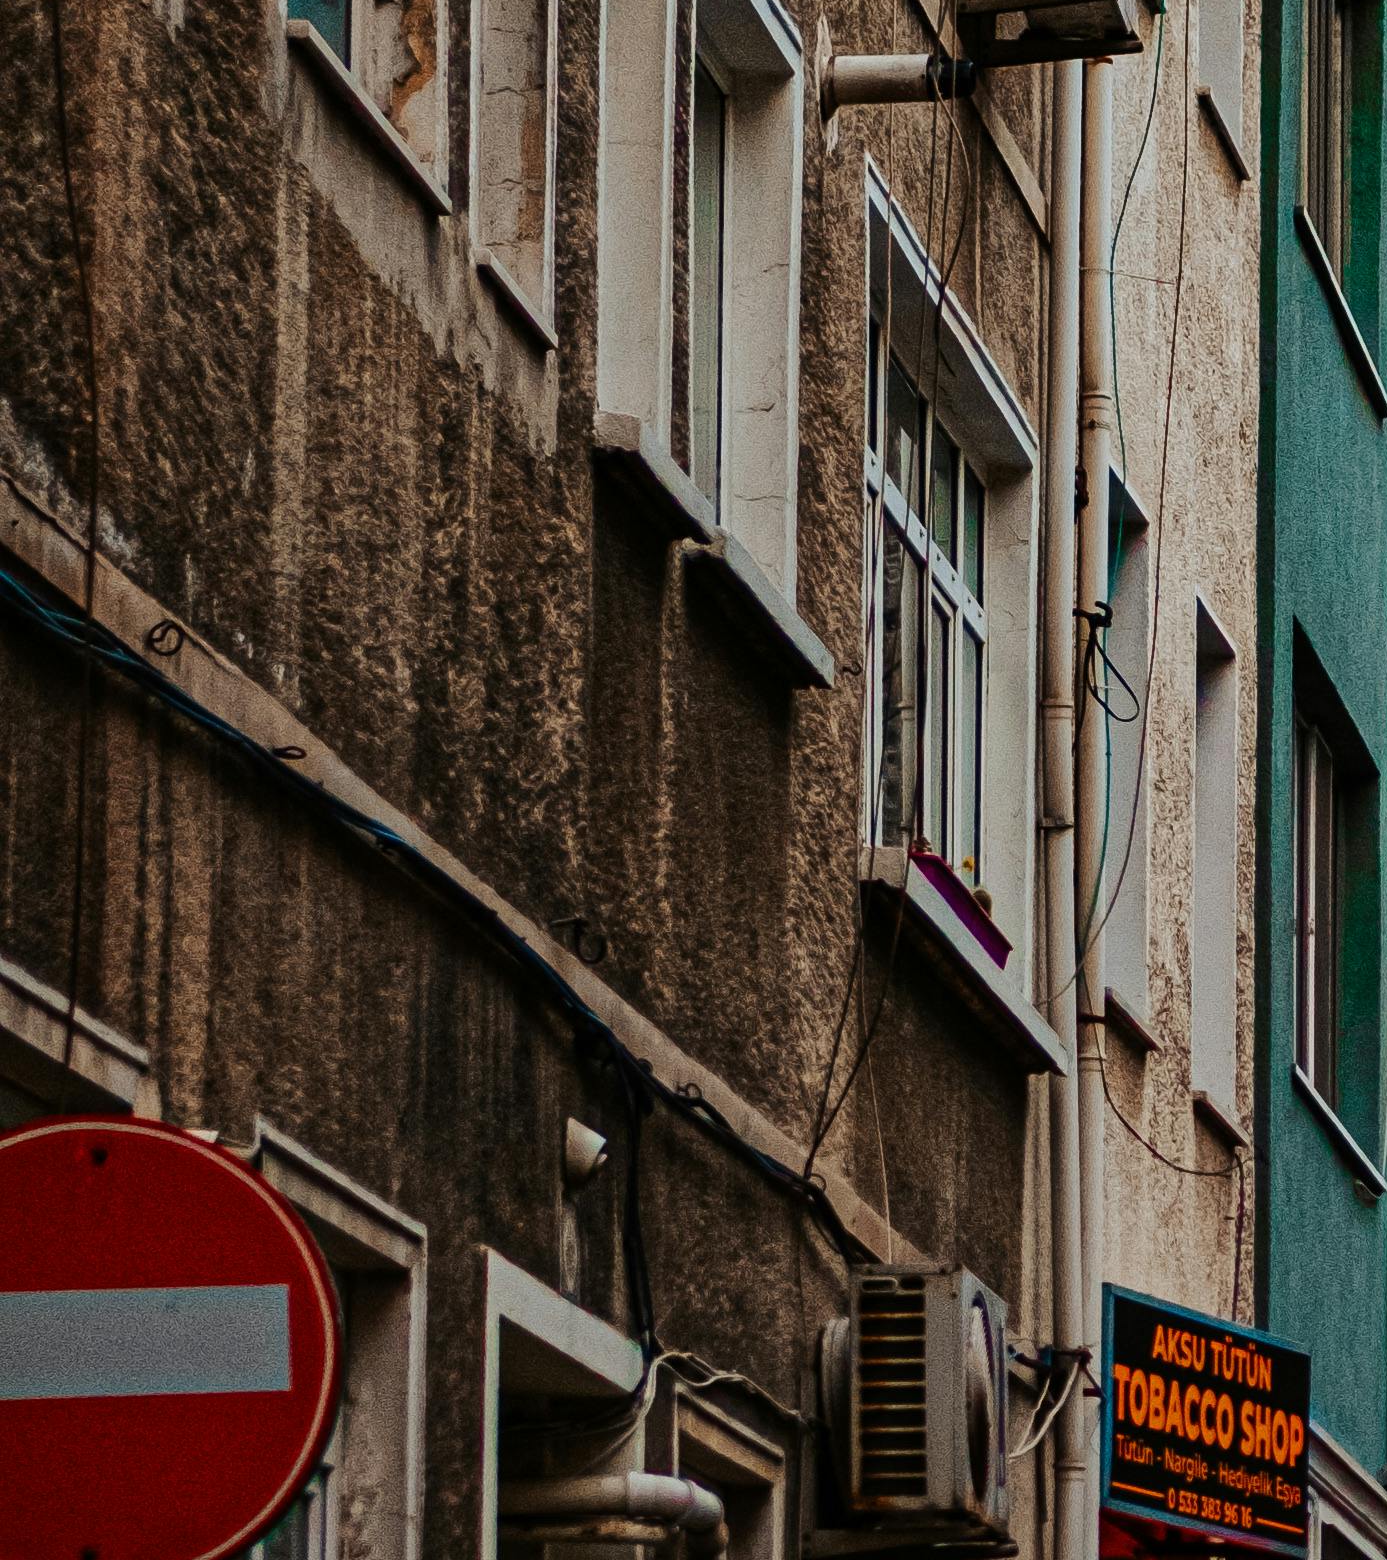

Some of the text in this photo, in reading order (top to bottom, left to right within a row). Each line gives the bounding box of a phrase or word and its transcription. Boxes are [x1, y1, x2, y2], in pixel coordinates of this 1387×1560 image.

[1152, 1324, 1272, 1391] AKSU TÜTÜN
[1114, 1363, 1304, 1467] TOBACCO SHOP
[1116, 1434, 1154, 1465] Tütün
[1164, 1448, 1208, 1482] Nargile
[1219, 1462, 1272, 1496] Hediyelik
[1276, 1476, 1301, 1509] Eşya
[1168, 1487, 1252, 1529] 0 533 383 96 16
